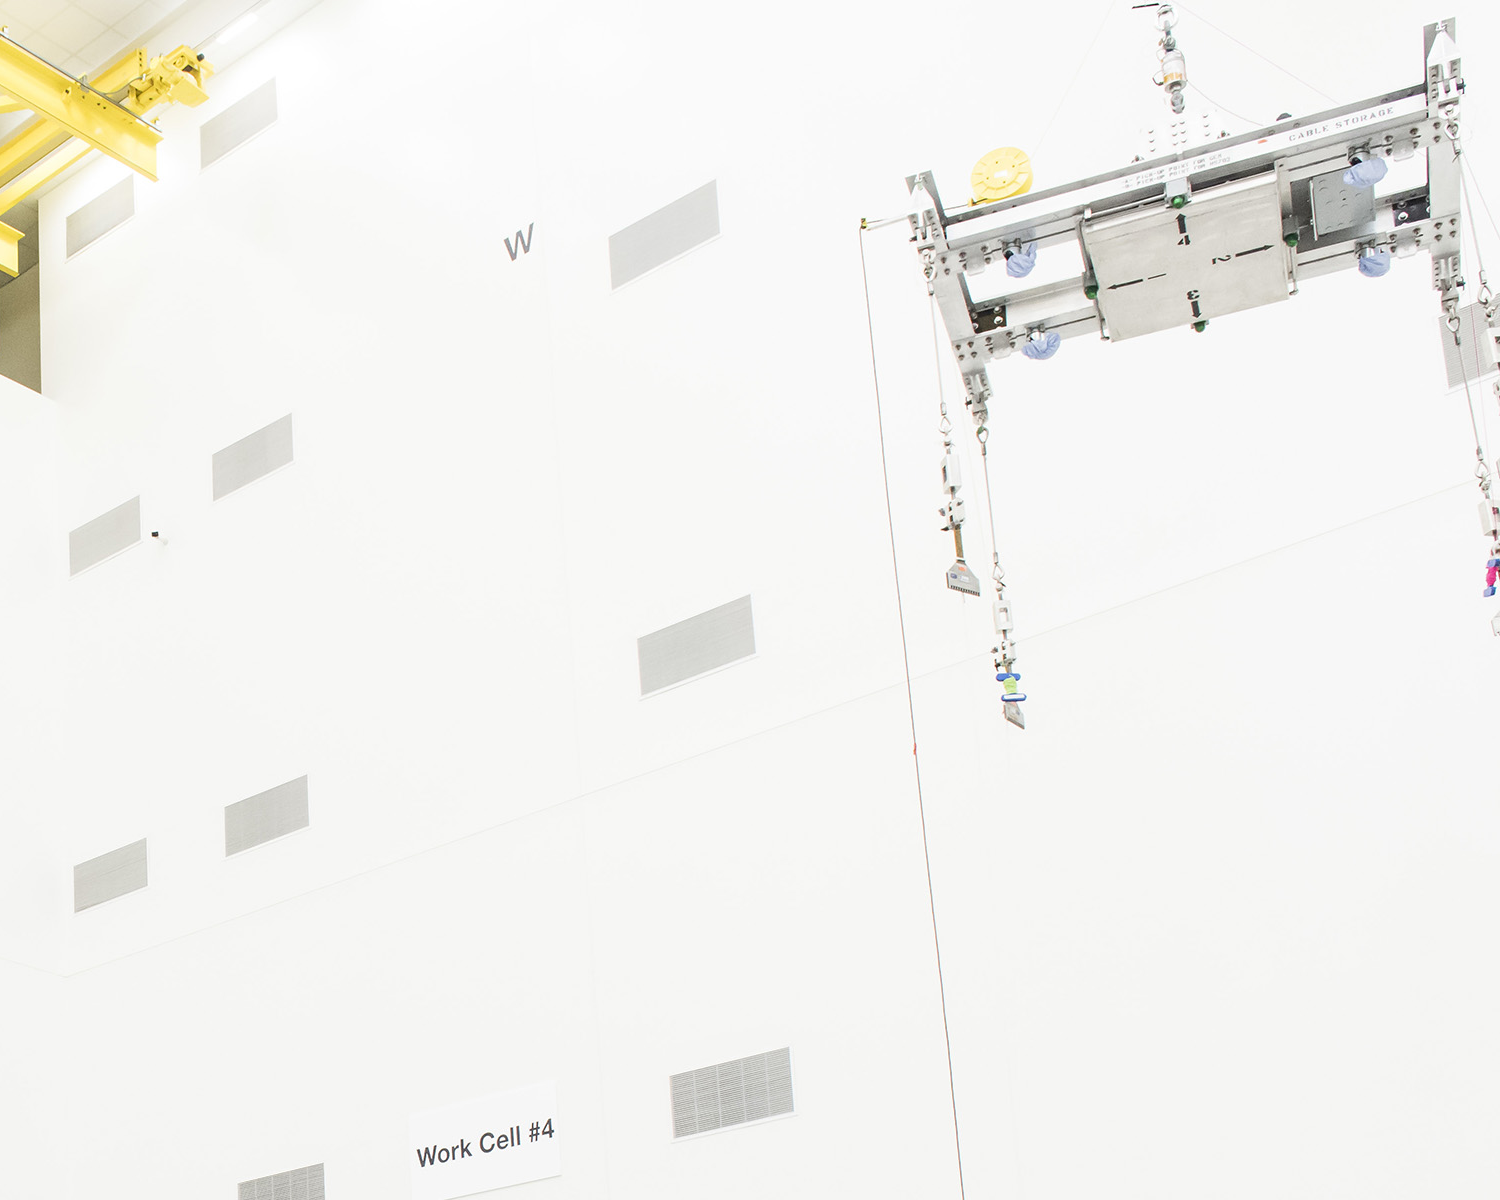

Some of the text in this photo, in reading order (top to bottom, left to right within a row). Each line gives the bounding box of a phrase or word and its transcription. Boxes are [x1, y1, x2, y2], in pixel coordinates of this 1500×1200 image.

[1288, 107, 1394, 142] CABLE STORAGE
[503, 222, 534, 262] W
[1211, 254, 1231, 265] 2
[1186, 289, 1200, 300] 3
[416, 1118, 555, 1168] Work Cell #4
